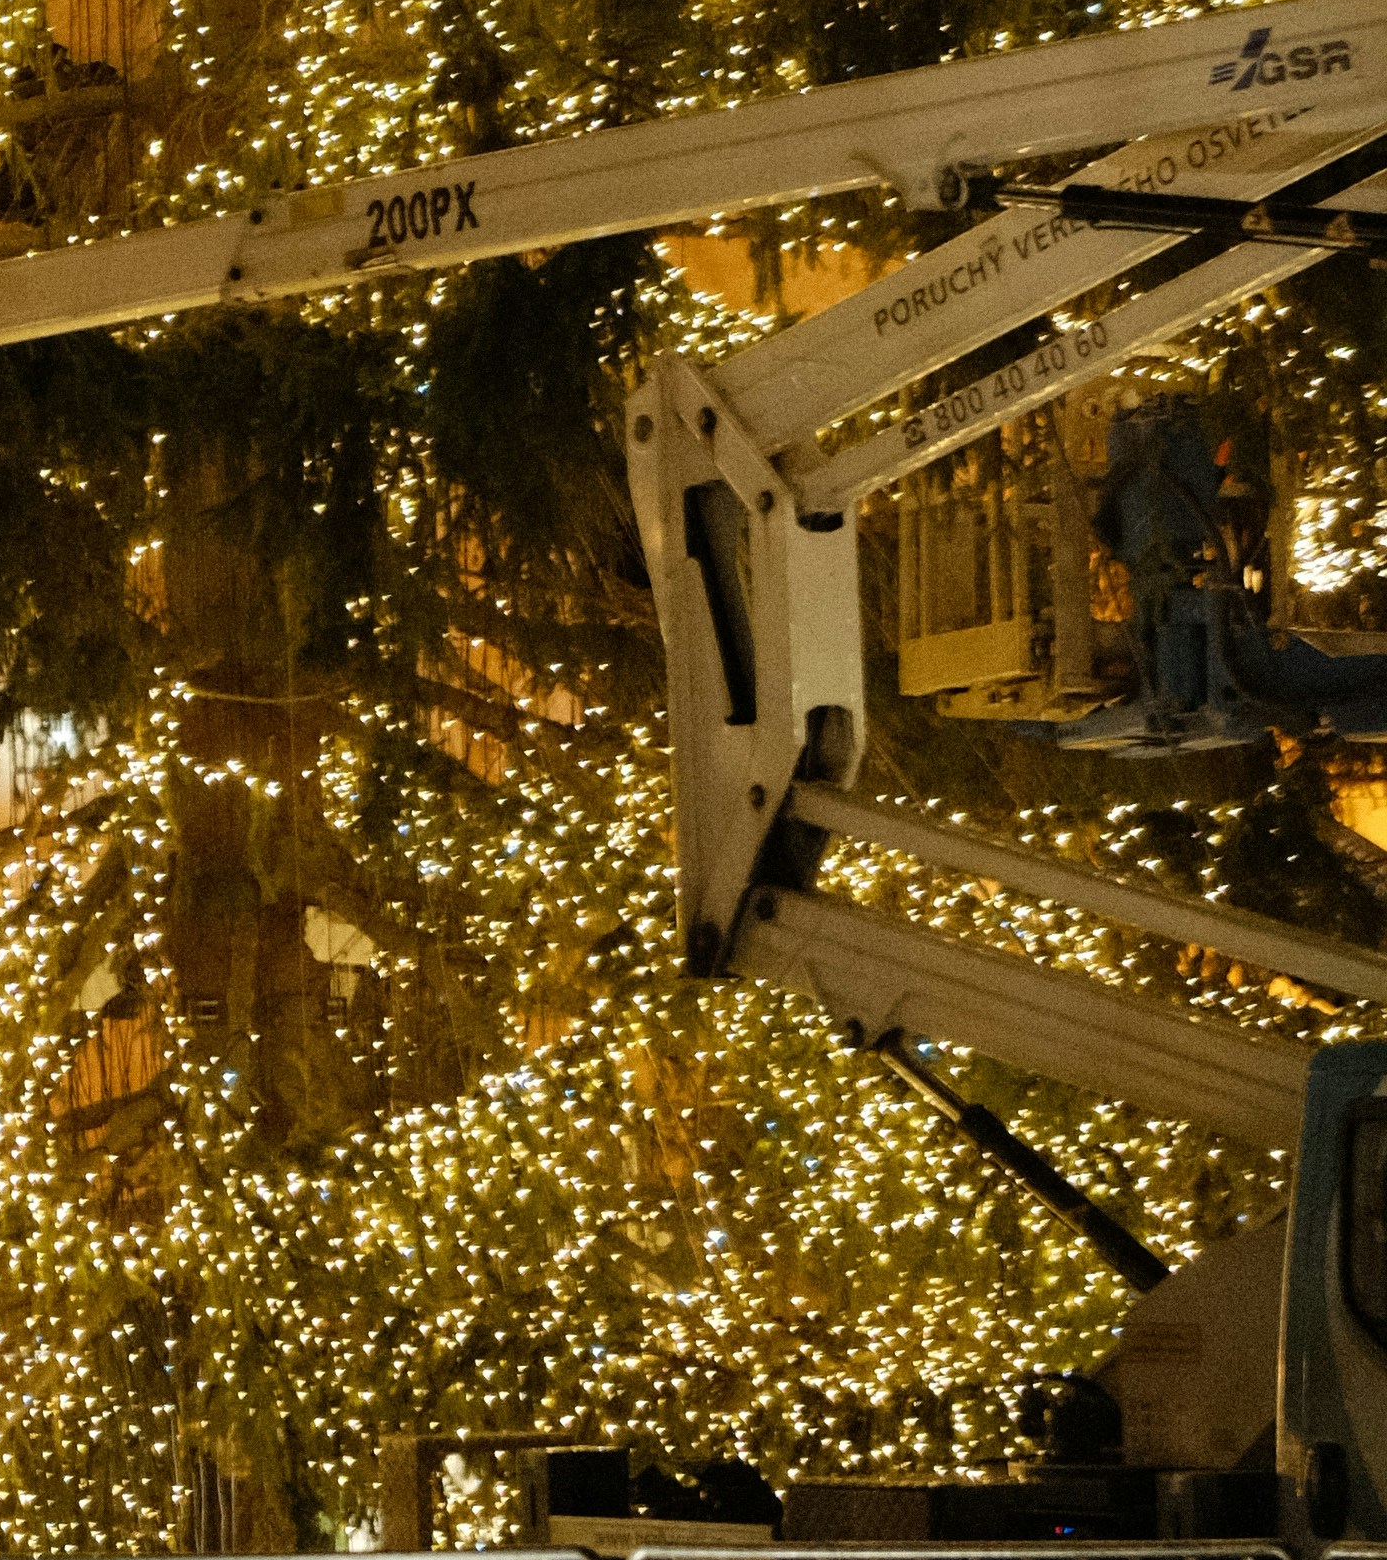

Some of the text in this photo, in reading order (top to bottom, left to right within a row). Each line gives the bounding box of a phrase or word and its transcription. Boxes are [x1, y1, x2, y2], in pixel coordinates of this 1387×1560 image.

[365, 180, 480, 247] 200PX
[873, 244, 1004, 336] PORUCHY
[934, 321, 1109, 432] 800 40 40 60
